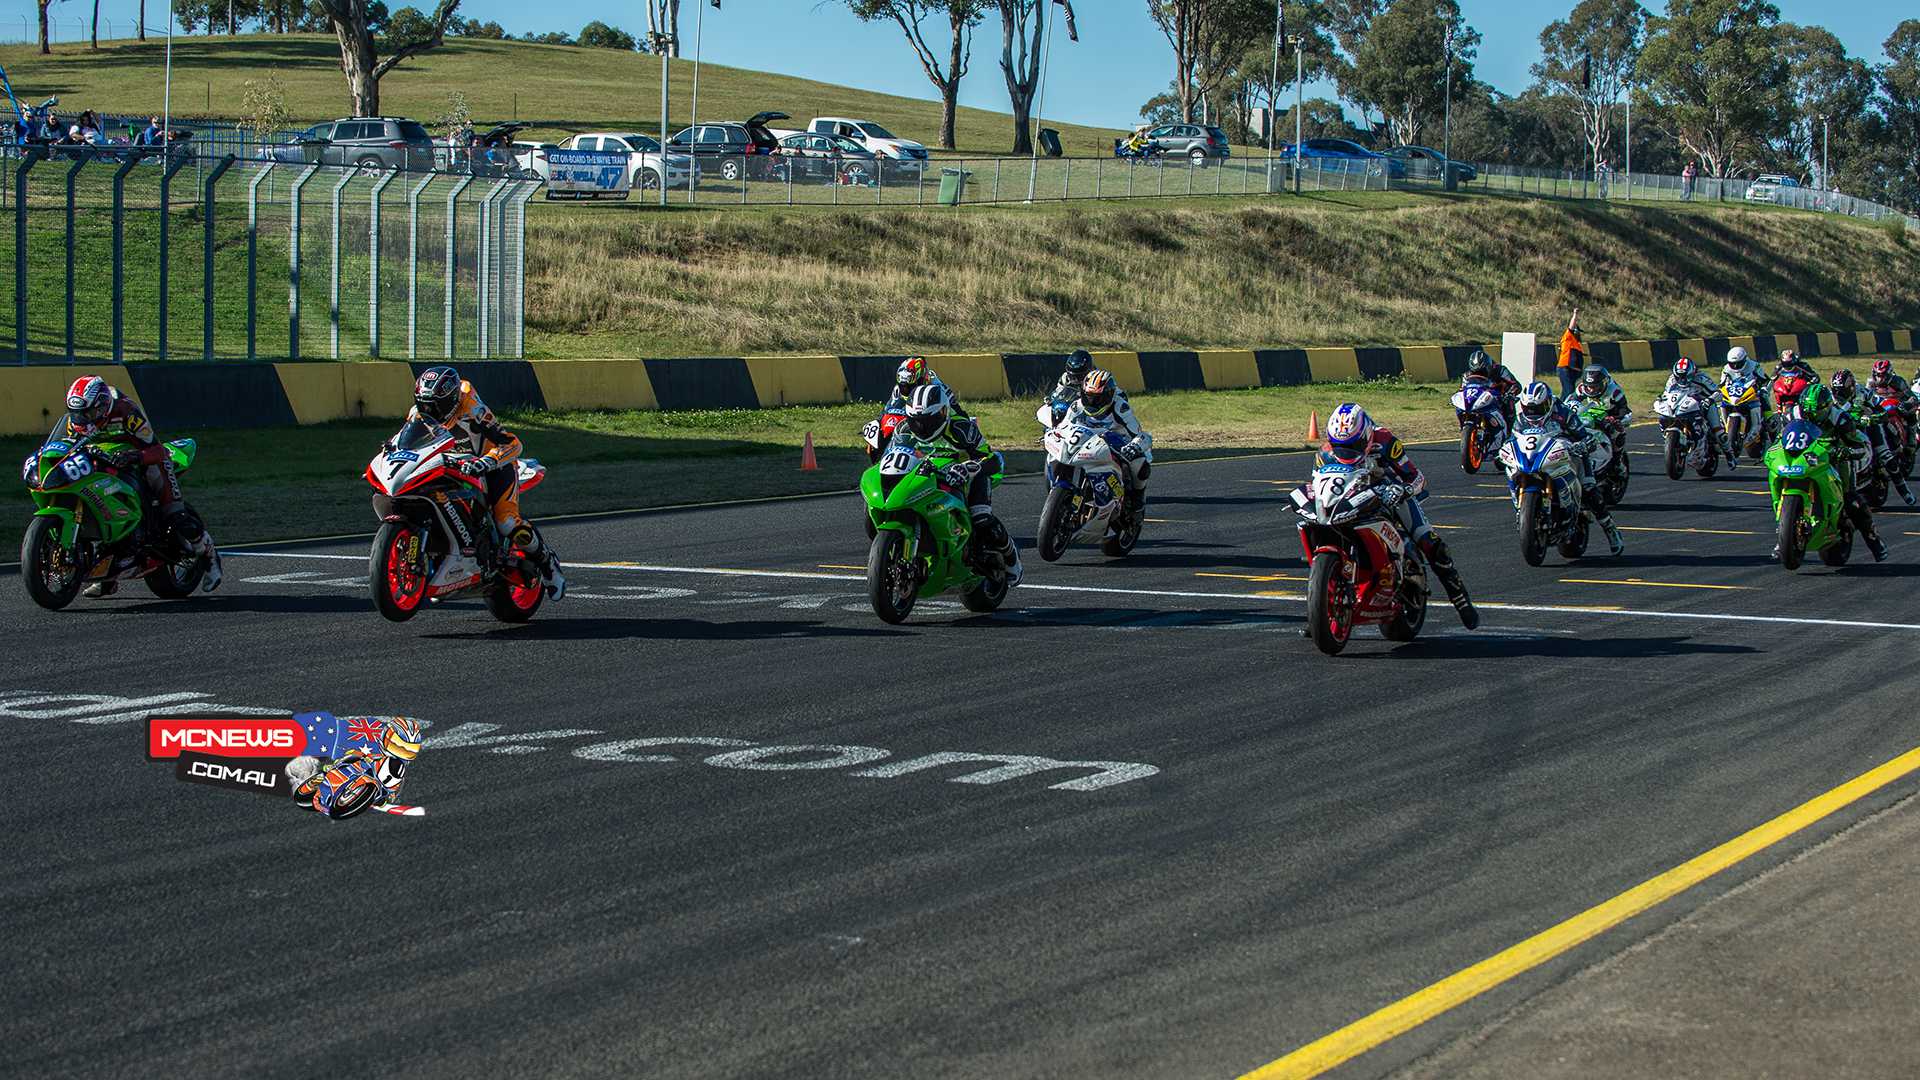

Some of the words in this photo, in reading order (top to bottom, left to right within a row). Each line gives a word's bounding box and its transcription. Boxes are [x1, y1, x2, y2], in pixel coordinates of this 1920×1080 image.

[549, 154, 559, 163] GET
[611, 156, 626, 165] TRAIN
[596, 167, 623, 189] 47
[1728, 386, 1744, 397] 33
[1069, 430, 1084, 446] 5
[1525, 436, 1538, 451] 3
[1785, 431, 1809, 450] 23
[63, 453, 92, 481] 65
[386, 460, 407, 480] 7
[881, 452, 911, 471] 20
[1319, 476, 1346, 496] 78
